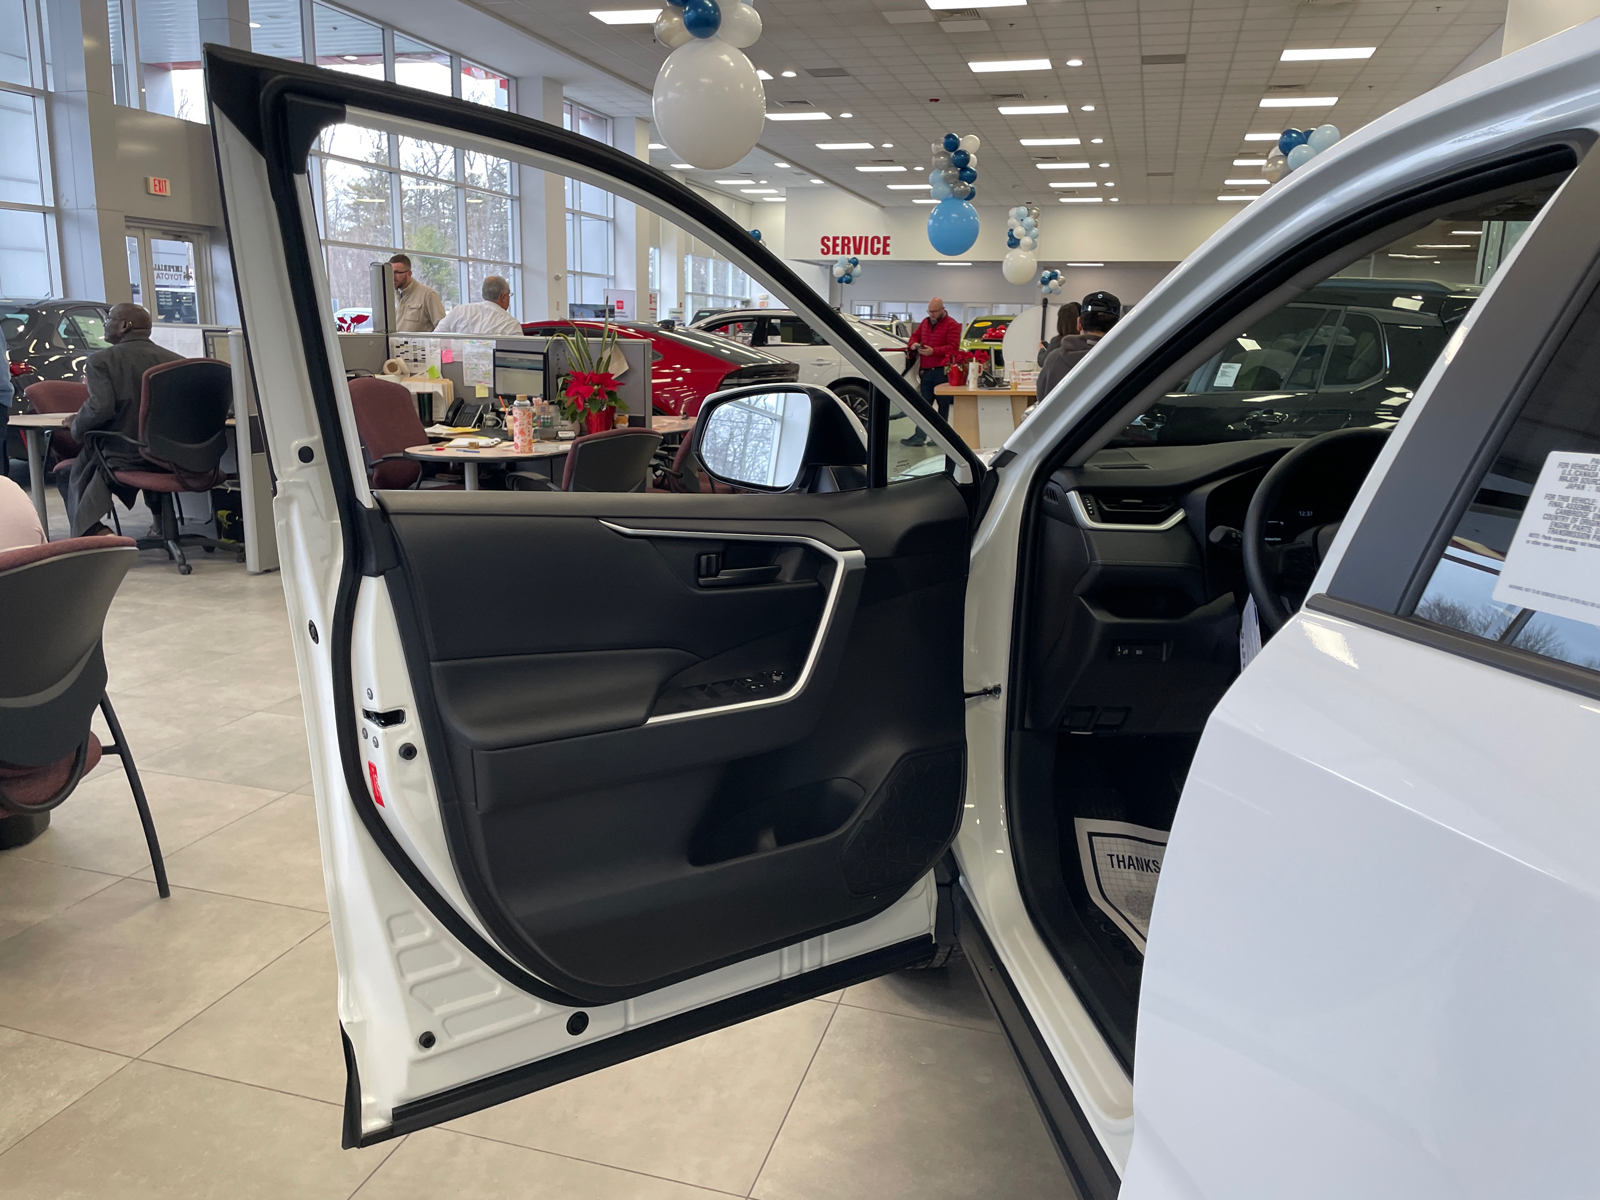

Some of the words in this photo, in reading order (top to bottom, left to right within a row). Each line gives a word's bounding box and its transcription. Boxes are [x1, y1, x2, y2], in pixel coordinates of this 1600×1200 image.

[153, 178, 167, 194] EXIT
[820, 235, 891, 256] SERVICE
[1106, 853, 1161, 874] THANKS
